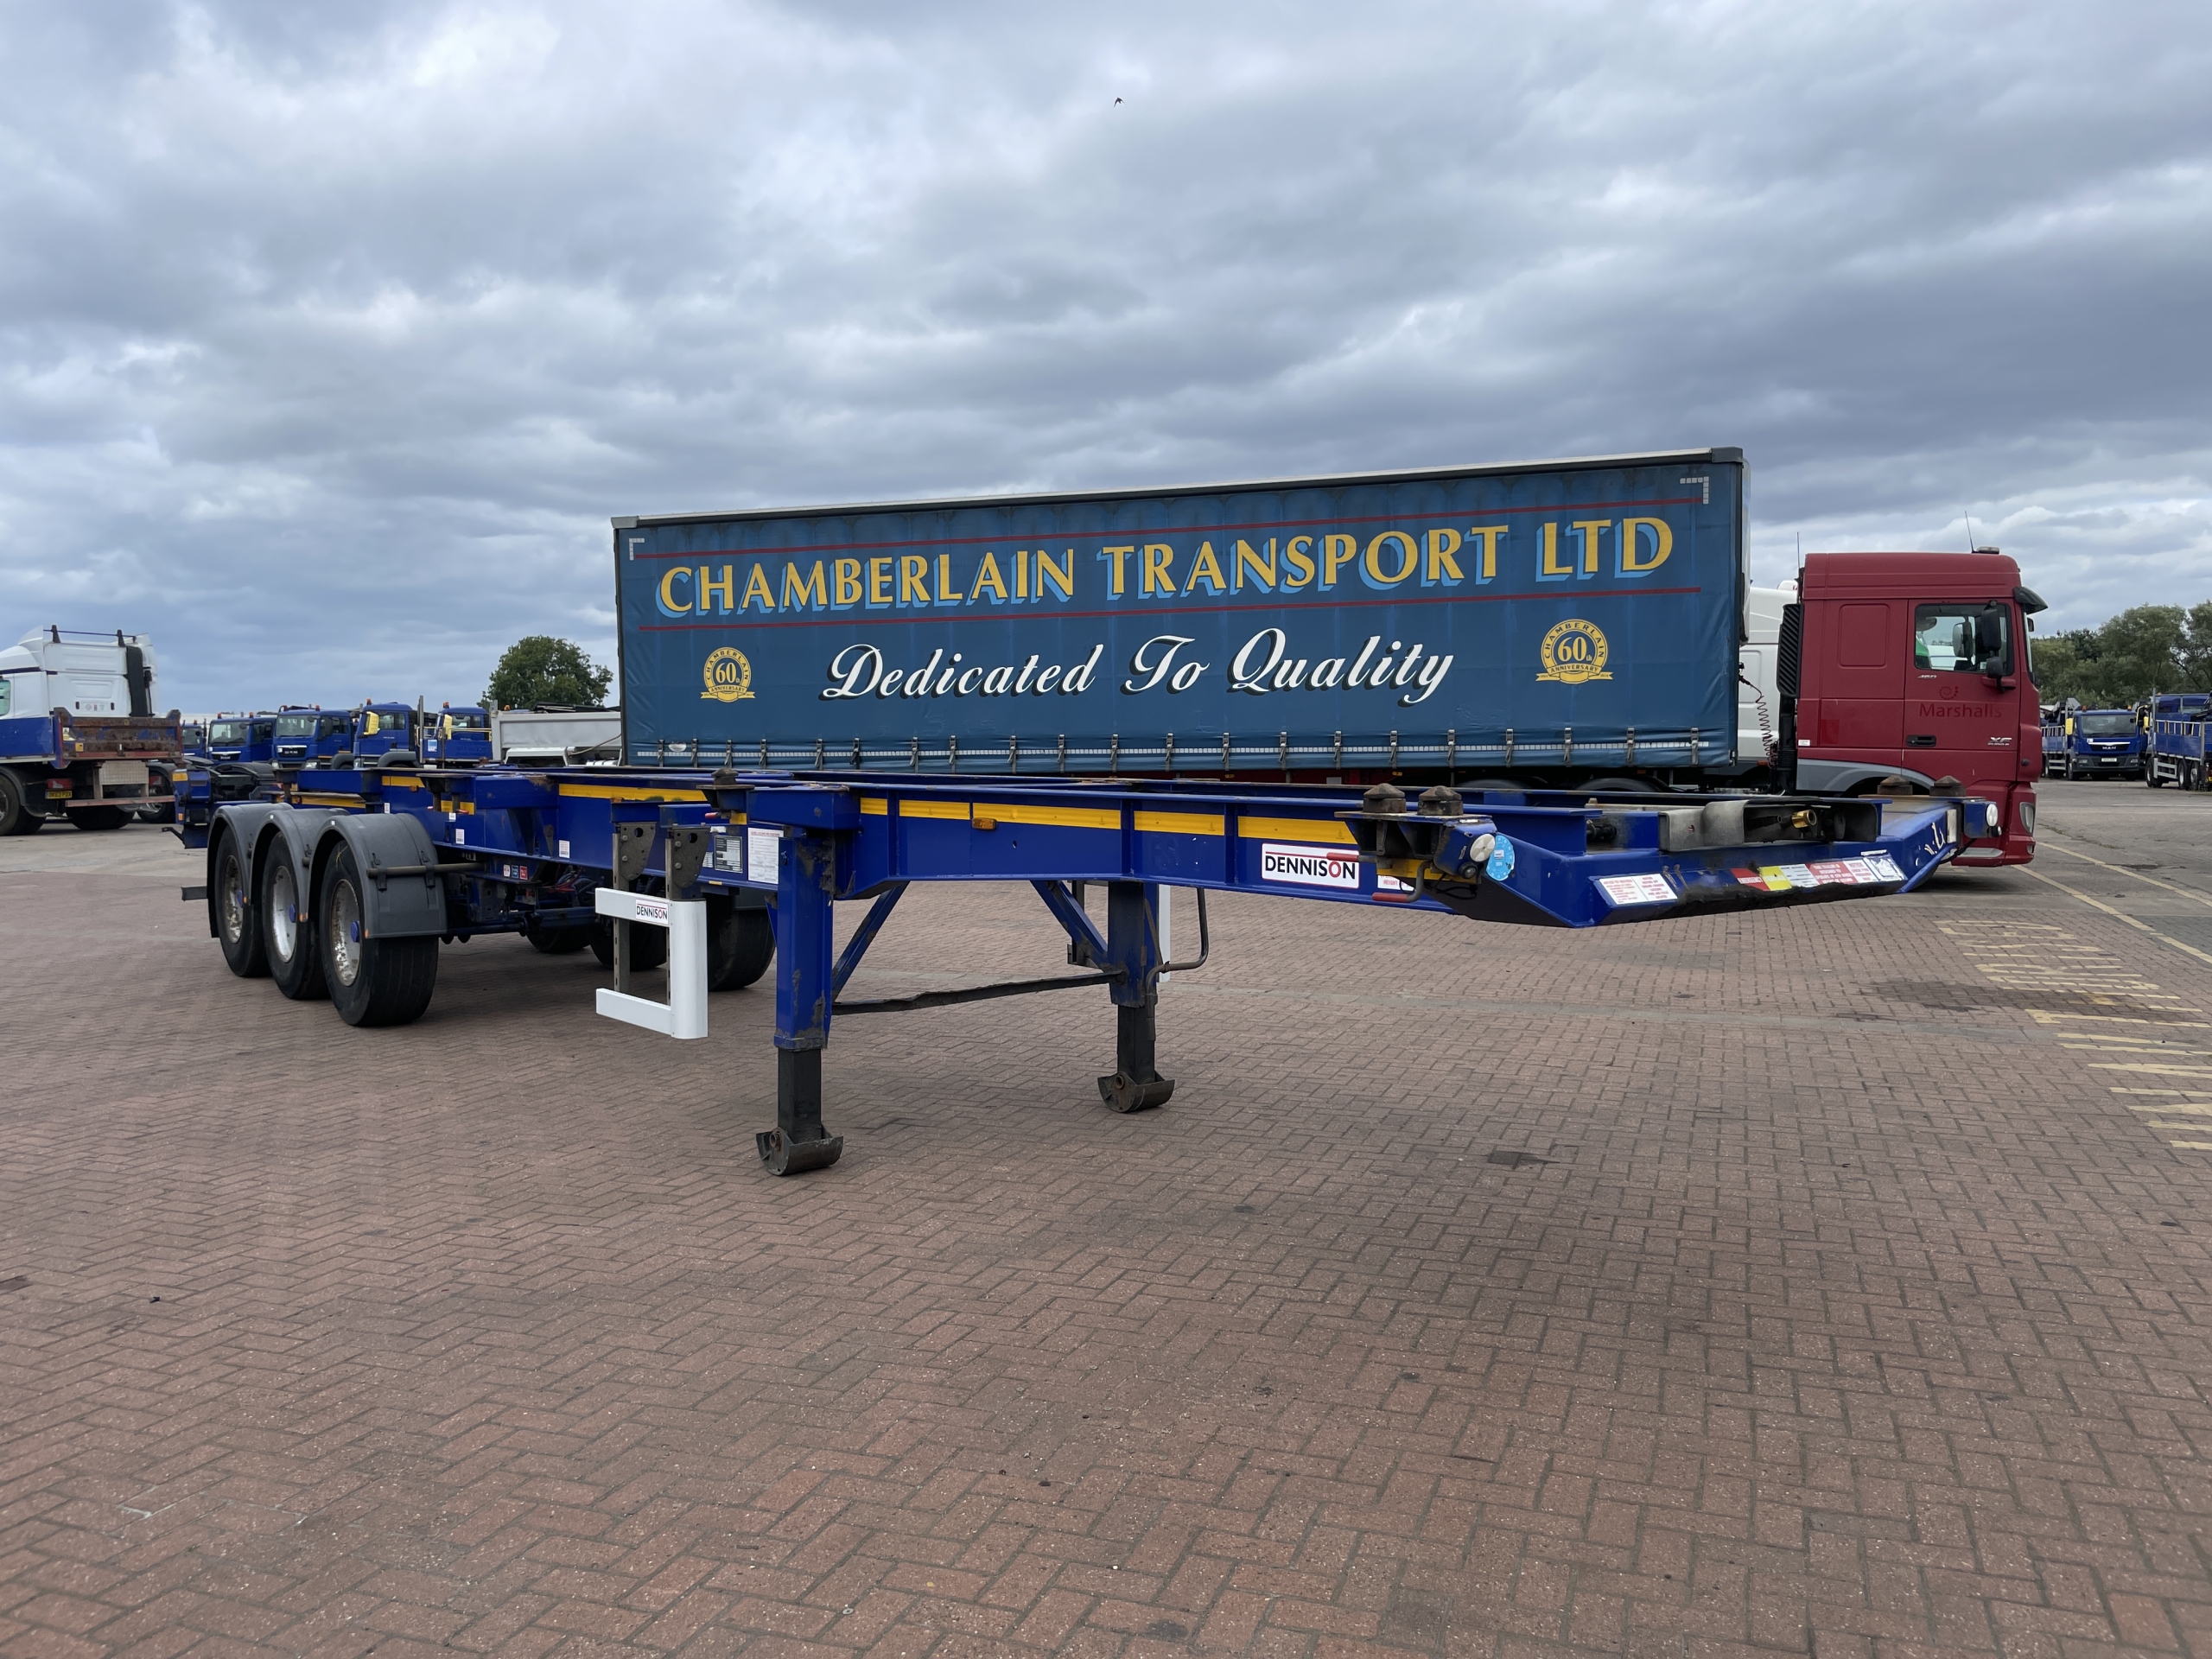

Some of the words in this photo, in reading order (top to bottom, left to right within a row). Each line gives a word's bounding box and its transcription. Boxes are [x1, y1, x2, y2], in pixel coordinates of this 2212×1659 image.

[657, 548, 1074, 617] CHAMBERLAIN
[1096, 525, 1509, 600] TRANSPORT
[1535, 517, 1674, 582] LTD
[1544, 622, 1605, 659] CHAMBERLAIN
[820, 644, 1104, 702] Dedicated
[1122, 635, 1211, 694] To
[1227, 627, 1454, 707] Quality
[1550, 664, 1599, 673] ANNIVERSARY
[1919, 702, 2002, 718] Marshalls
[1265, 855, 1356, 880] DENNISON
[636, 906, 668, 920] DENNISON
